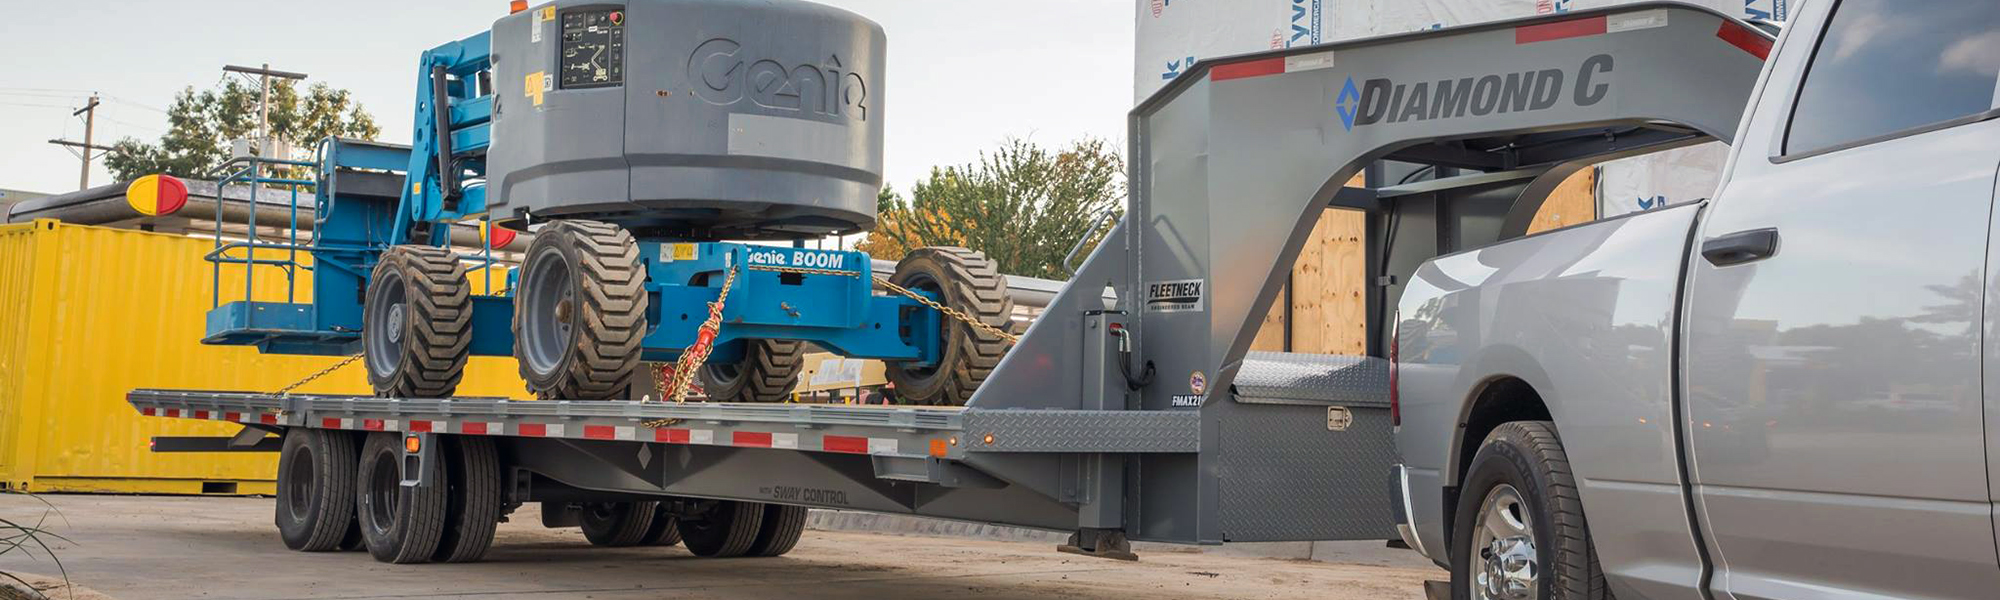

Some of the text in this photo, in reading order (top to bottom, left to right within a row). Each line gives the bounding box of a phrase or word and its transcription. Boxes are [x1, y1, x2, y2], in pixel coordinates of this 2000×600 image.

[687, 37, 866, 121] Genie
[1573, 54, 1614, 107] C
[793, 251, 843, 268] BOOM
[1149, 282, 1201, 298] FLEETNECK
[1172, 395, 1204, 406] FMAX21
[774, 486, 801, 500] SWAY
[804, 488, 848, 504] CONTROL
